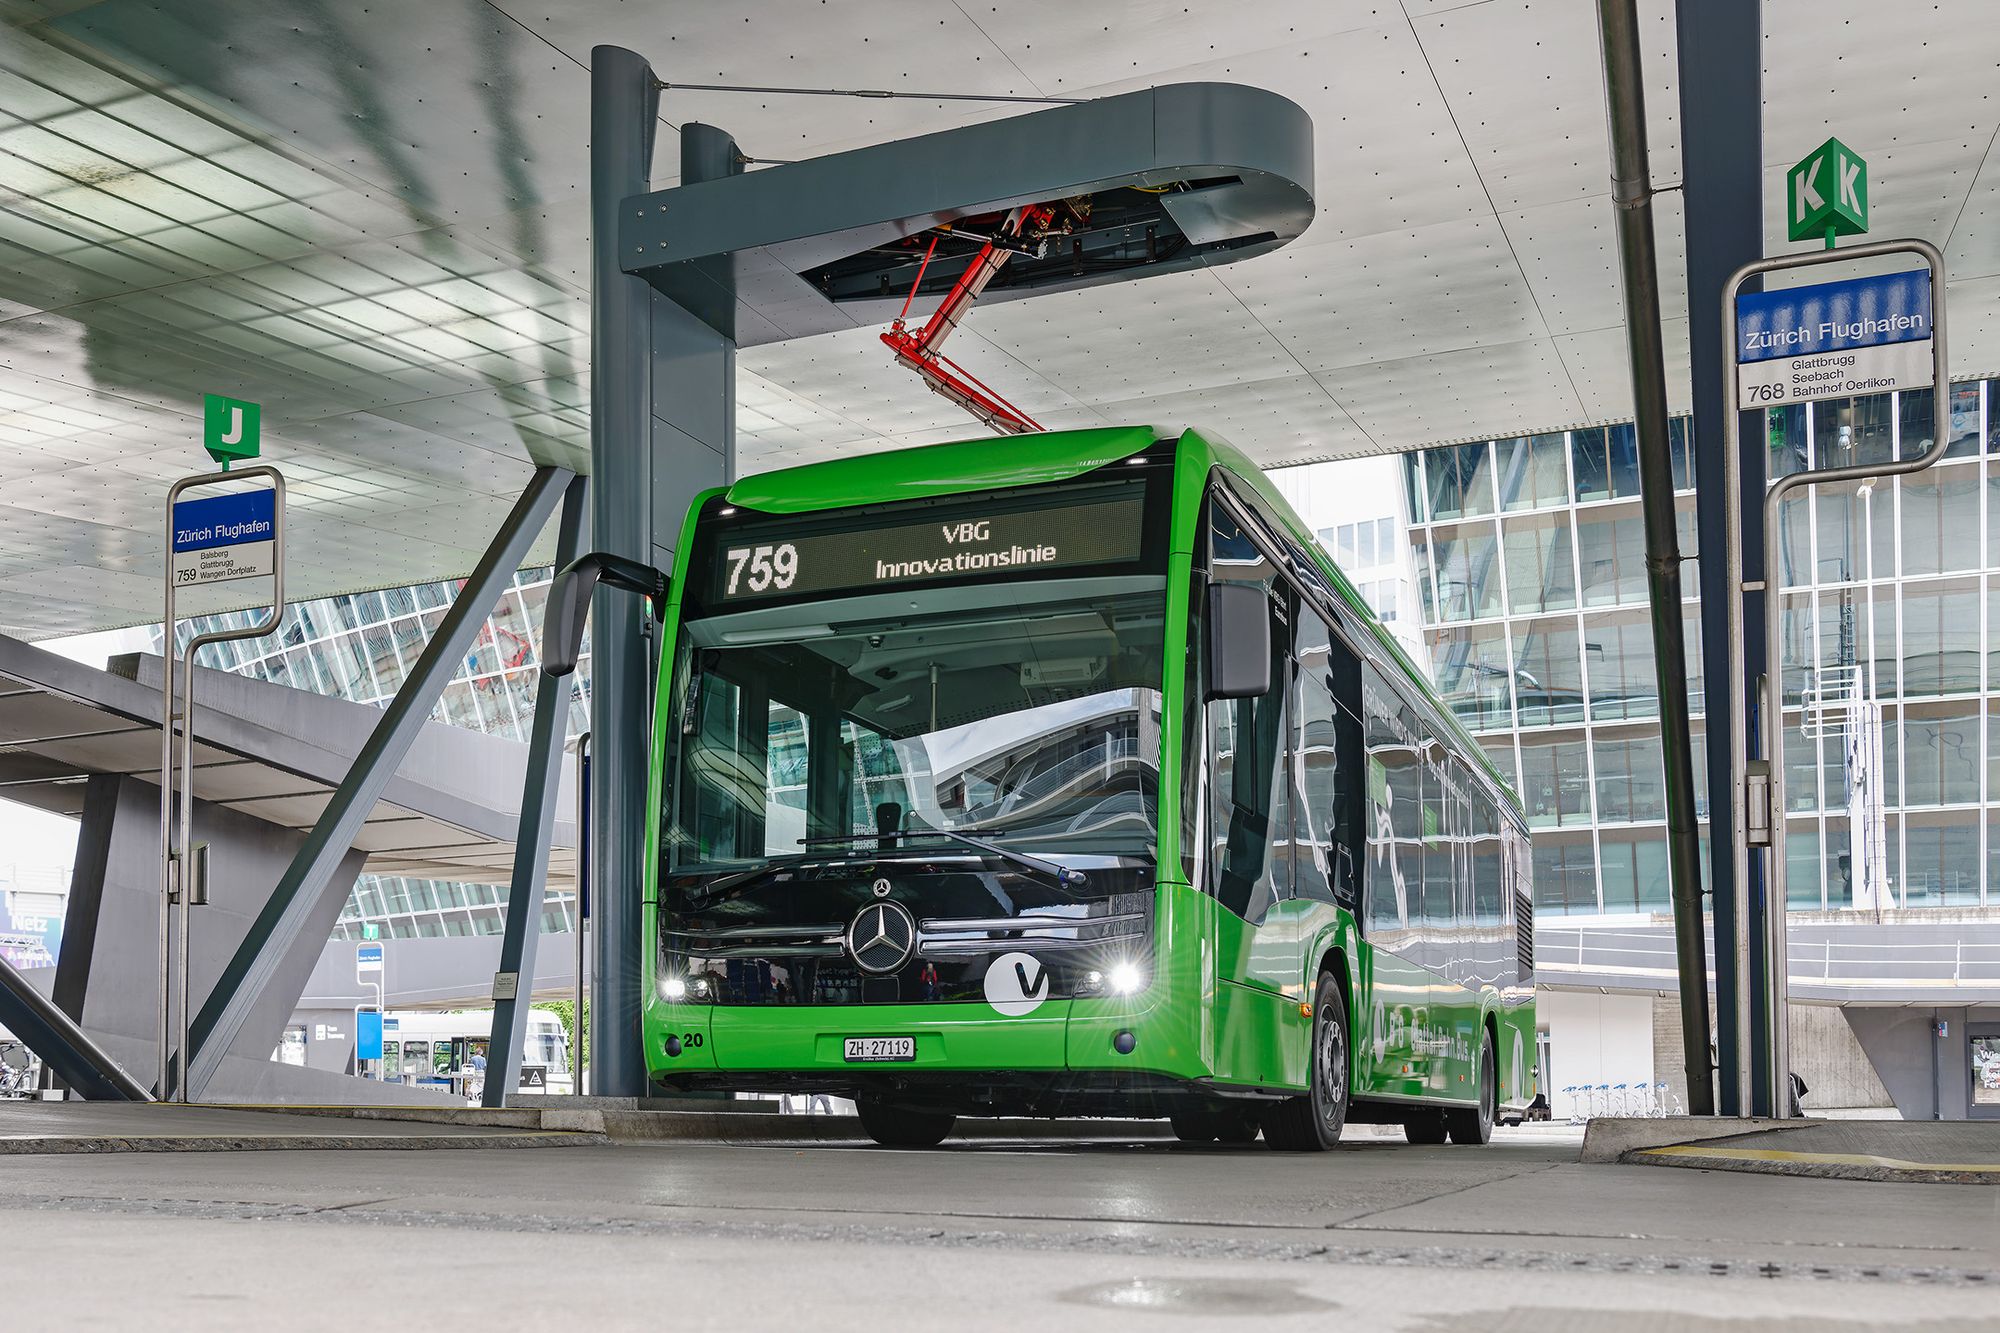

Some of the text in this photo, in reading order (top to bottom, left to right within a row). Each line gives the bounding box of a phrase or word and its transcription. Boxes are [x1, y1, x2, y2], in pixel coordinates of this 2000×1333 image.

[1795, 155, 1826, 224] K
[1840, 153, 1863, 218] K
[1745, 313, 1923, 350] Zürich Flughafen
[1791, 355, 1856, 371] Glattbrugg
[1791, 369, 1844, 384] Seebach
[1792, 376, 1896, 397] Bahnhof Oerlikon
[1747, 383, 1785, 402] 768
[221, 407, 243, 445] J
[177, 520, 270, 543] Zürich Flughafen
[942, 521, 990, 544] VBG
[200, 550, 229, 560] Balsberg
[200, 559, 234, 570] Glattbrugg
[876, 543, 1057, 579] Innovationslinie
[177, 568, 197, 582] 759
[200, 565, 257, 580] Wangen Dorfplatz
[727, 543, 799, 595] 759
[11, 913, 48, 932] Netz
[683, 1032, 704, 1048] 20
